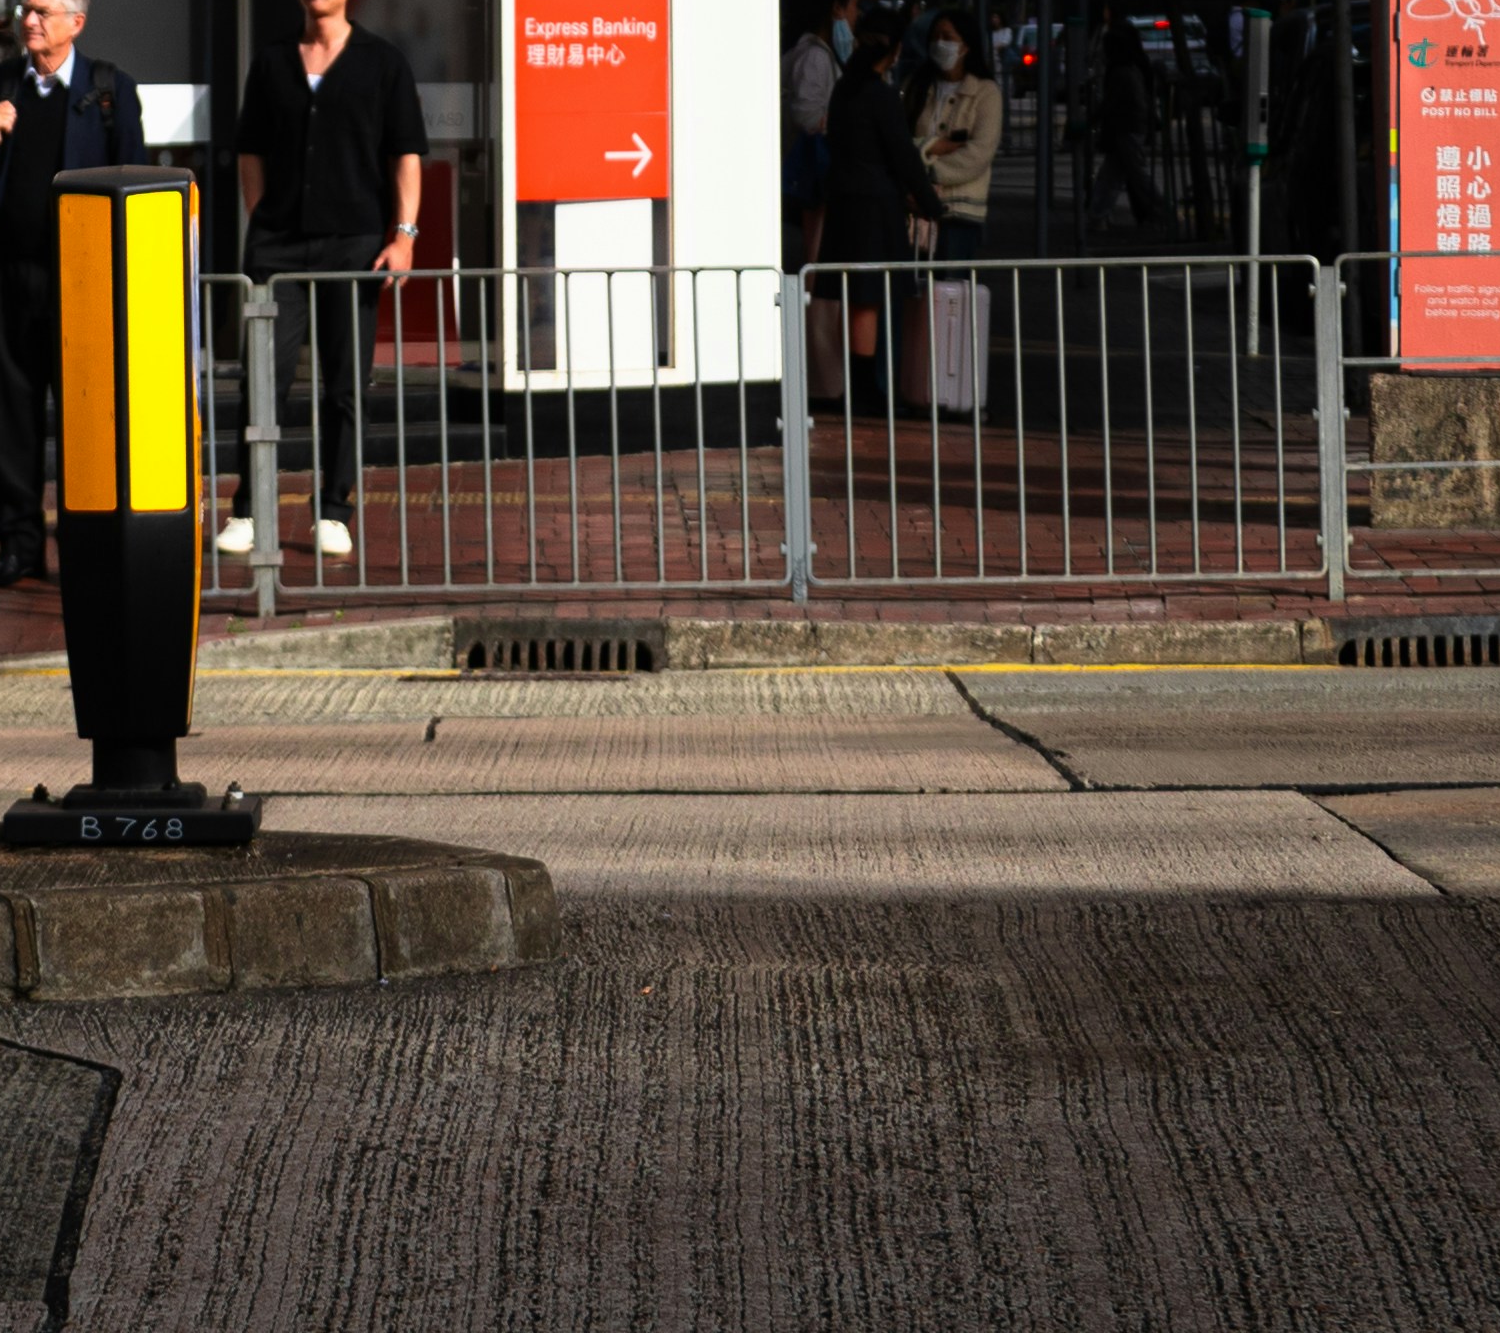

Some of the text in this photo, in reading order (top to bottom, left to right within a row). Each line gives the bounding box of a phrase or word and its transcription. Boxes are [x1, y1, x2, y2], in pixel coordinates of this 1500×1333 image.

[525, 17, 657, 42] Express Banking
[526, 43, 626, 68] 理財易中心
[1421, 106, 1498, 117] POST NO BILL
[1466, 145, 1492, 259] 小心過路
[81, 816, 183, 840] B 768
